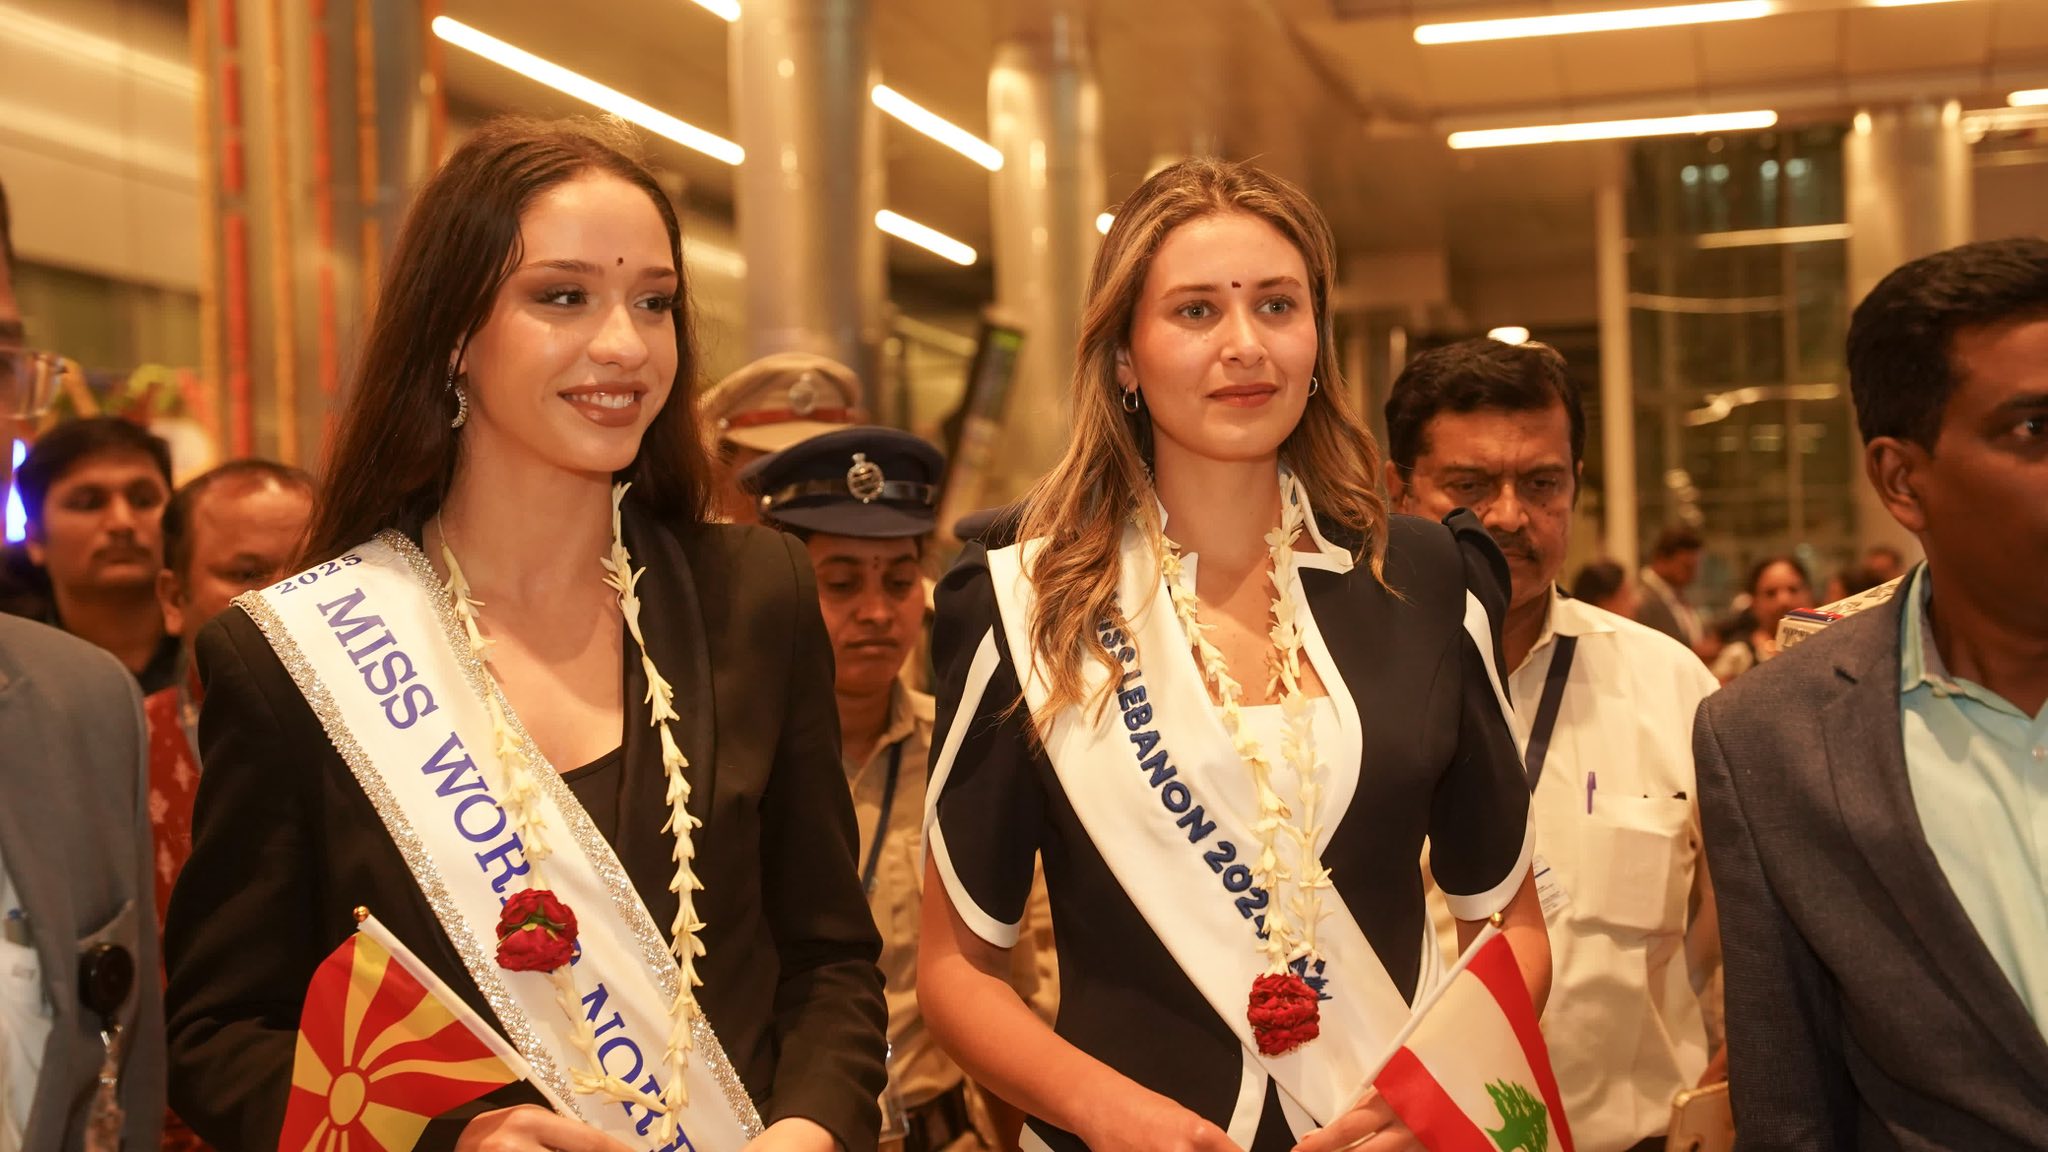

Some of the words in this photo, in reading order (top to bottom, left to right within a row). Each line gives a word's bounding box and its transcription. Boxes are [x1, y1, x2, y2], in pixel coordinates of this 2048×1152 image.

[275, 553, 363, 595] 2025
[316, 587, 440, 730] MISS
[420, 731, 582, 974] WOR
[1116, 669, 1217, 844] LEBANON
